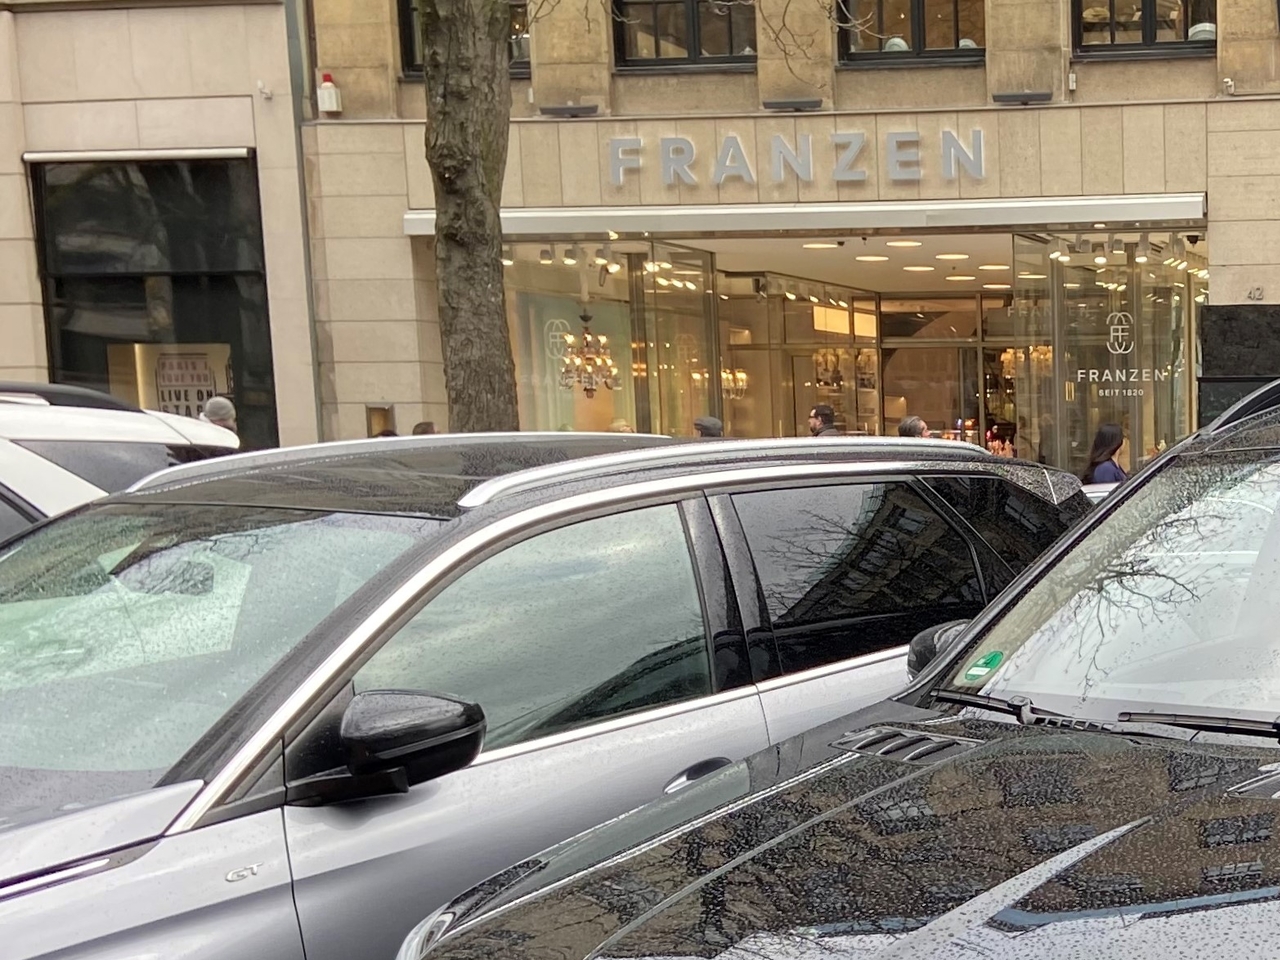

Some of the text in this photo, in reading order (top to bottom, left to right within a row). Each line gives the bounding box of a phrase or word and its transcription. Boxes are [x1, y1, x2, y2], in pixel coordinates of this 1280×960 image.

[608, 128, 986, 187] FRANZEN
[1247, 286, 1264, 301] 42
[1076, 368, 1166, 383] FRANZEN
[160, 389, 213, 402] LIVE ON
[1098, 388, 1145, 397] SEIT 1820
[225, 862, 264, 883] GT
